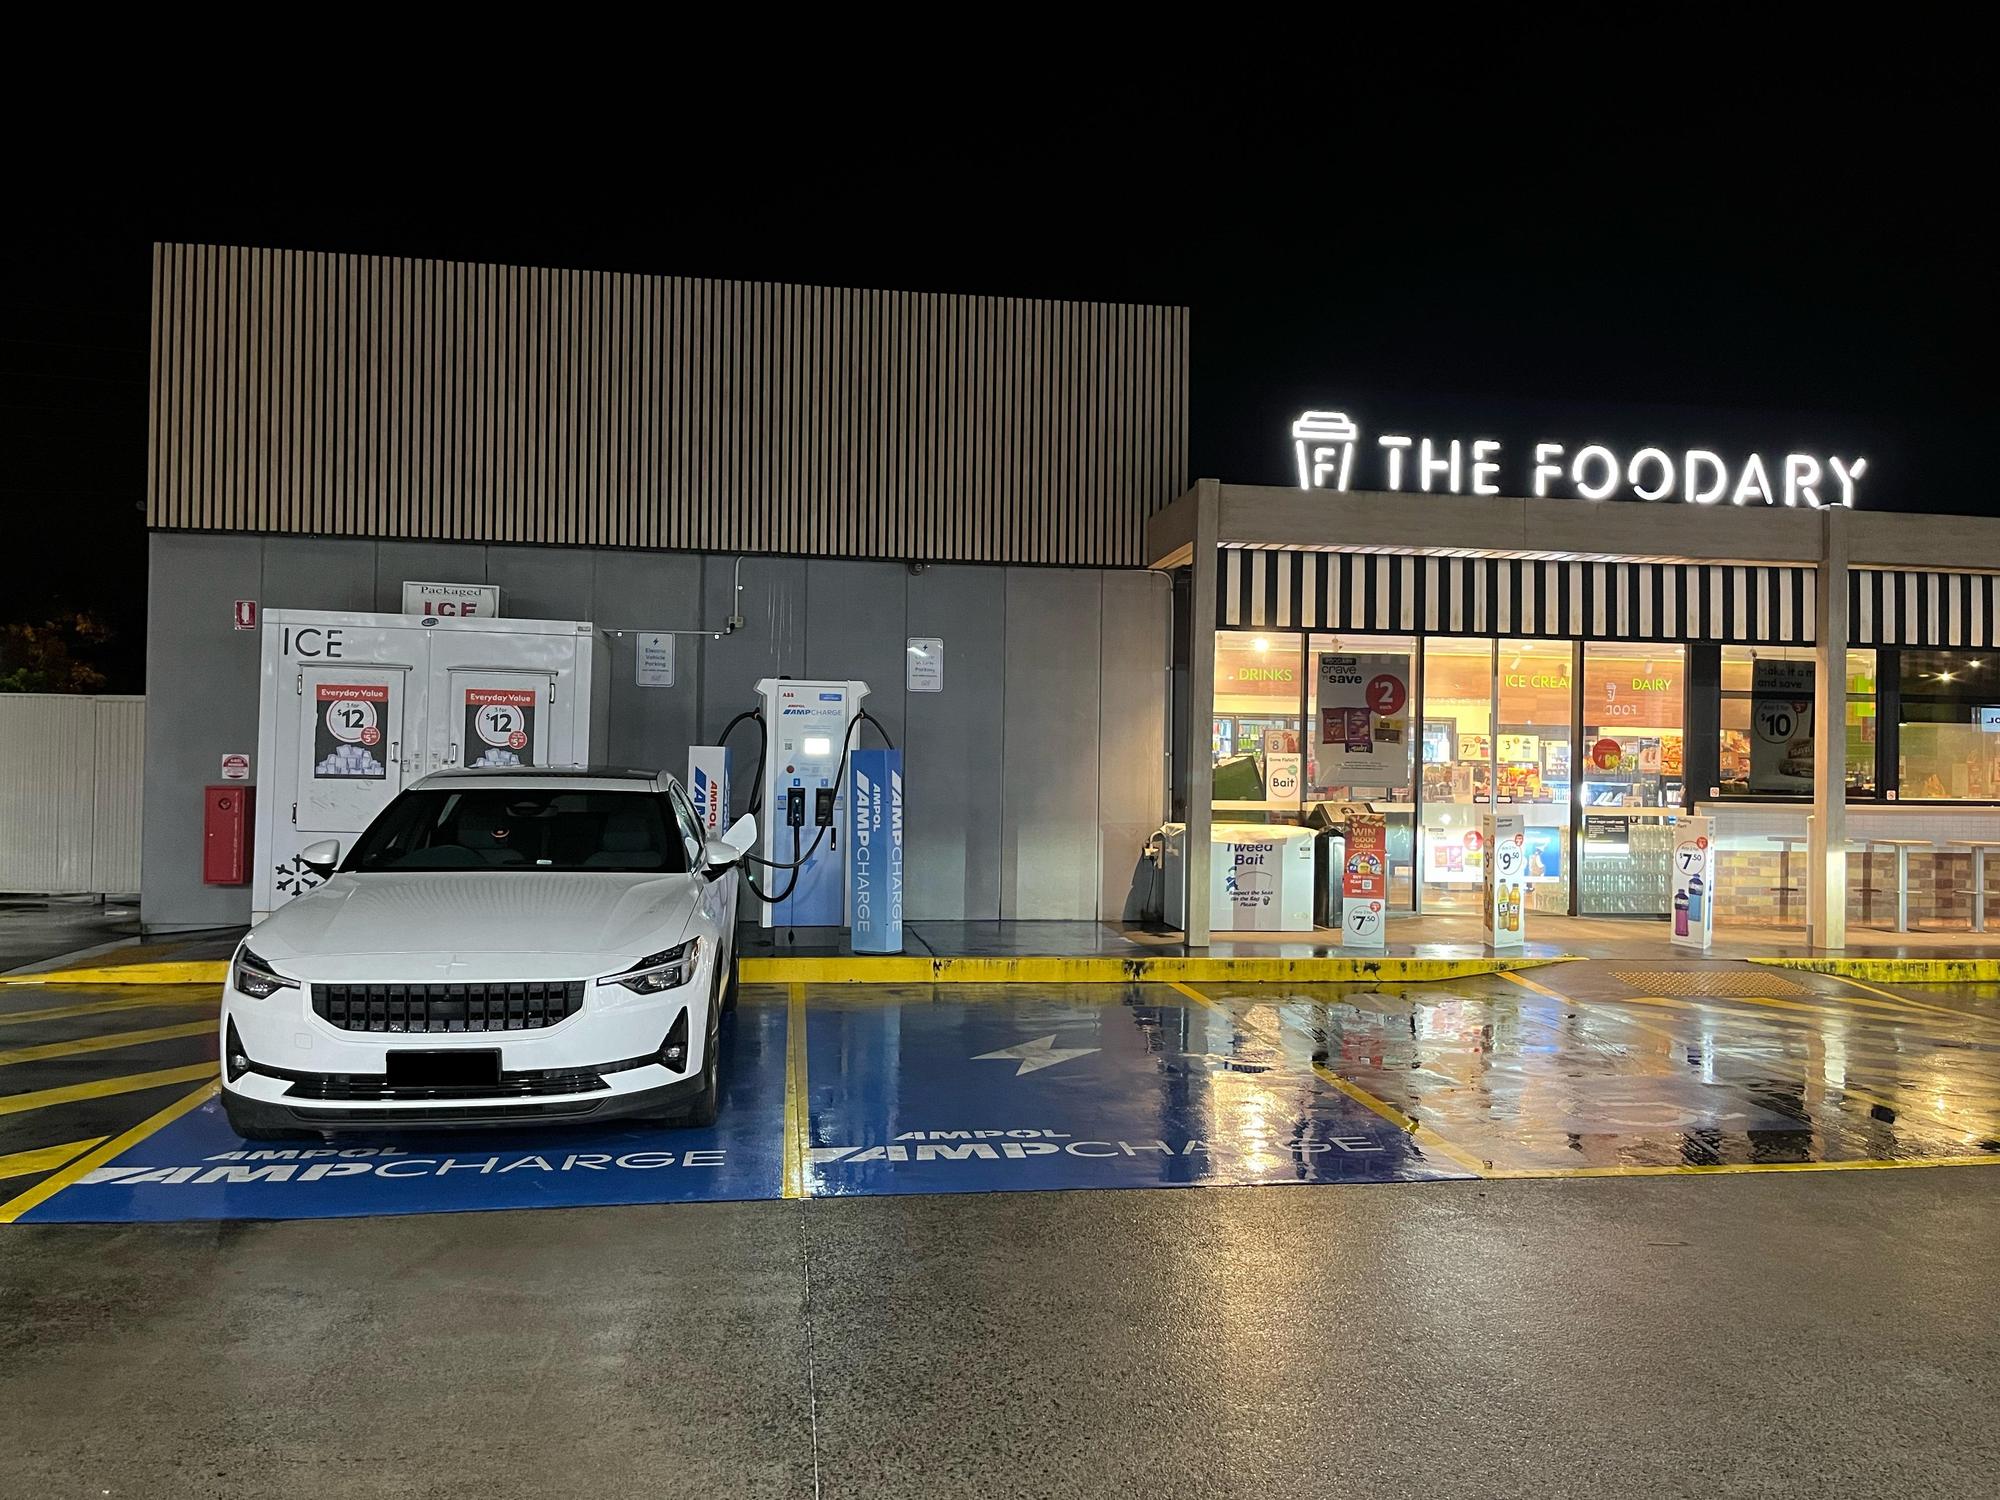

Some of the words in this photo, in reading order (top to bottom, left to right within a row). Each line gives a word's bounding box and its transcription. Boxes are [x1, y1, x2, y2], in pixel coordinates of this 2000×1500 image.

[1378, 434, 1501, 494] THE
[1535, 443, 1867, 508] FOODARY
[420, 585, 482, 597] Packaged
[284, 627, 343, 657] ICE
[1239, 668, 1292, 681] DRINKS
[1321, 665, 1357, 674] crave
[1328, 675, 1362, 684] save
[1505, 674, 1526, 688] ICE
[1531, 674, 1570, 689] CREA
[1632, 678, 1672, 691] DAIRY
[1757, 679, 1777, 687] and
[321, 688, 360, 698] Everyday
[470, 693, 508, 702] Everyday
[509, 694, 531, 702] Value
[1374, 681, 1394, 703] $2
[337, 709, 365, 728] $12
[789, 708, 842, 716] AMPCHARGE
[486, 713, 512, 732] $12
[1761, 713, 1791, 736] $10
[1272, 777, 1295, 787] Bait
[709, 780, 718, 829] AMPOL
[873, 783, 881, 832] AMPOL
[1352, 828, 1376, 836] WIN
[857, 787, 870, 932] AMPCHARGE
[891, 787, 903, 933] AMPCHARGE
[1234, 854, 1264, 865] Bait
[1499, 851, 1519, 870] $9.50
[1679, 853, 1702, 870] $7.50
[1353, 915, 1376, 930] $7.50
[893, 1129, 1072, 1141] AMPOL
[202, 1146, 408, 1161] AMPOL
[110, 1150, 726, 1184] AMPCHARGE
